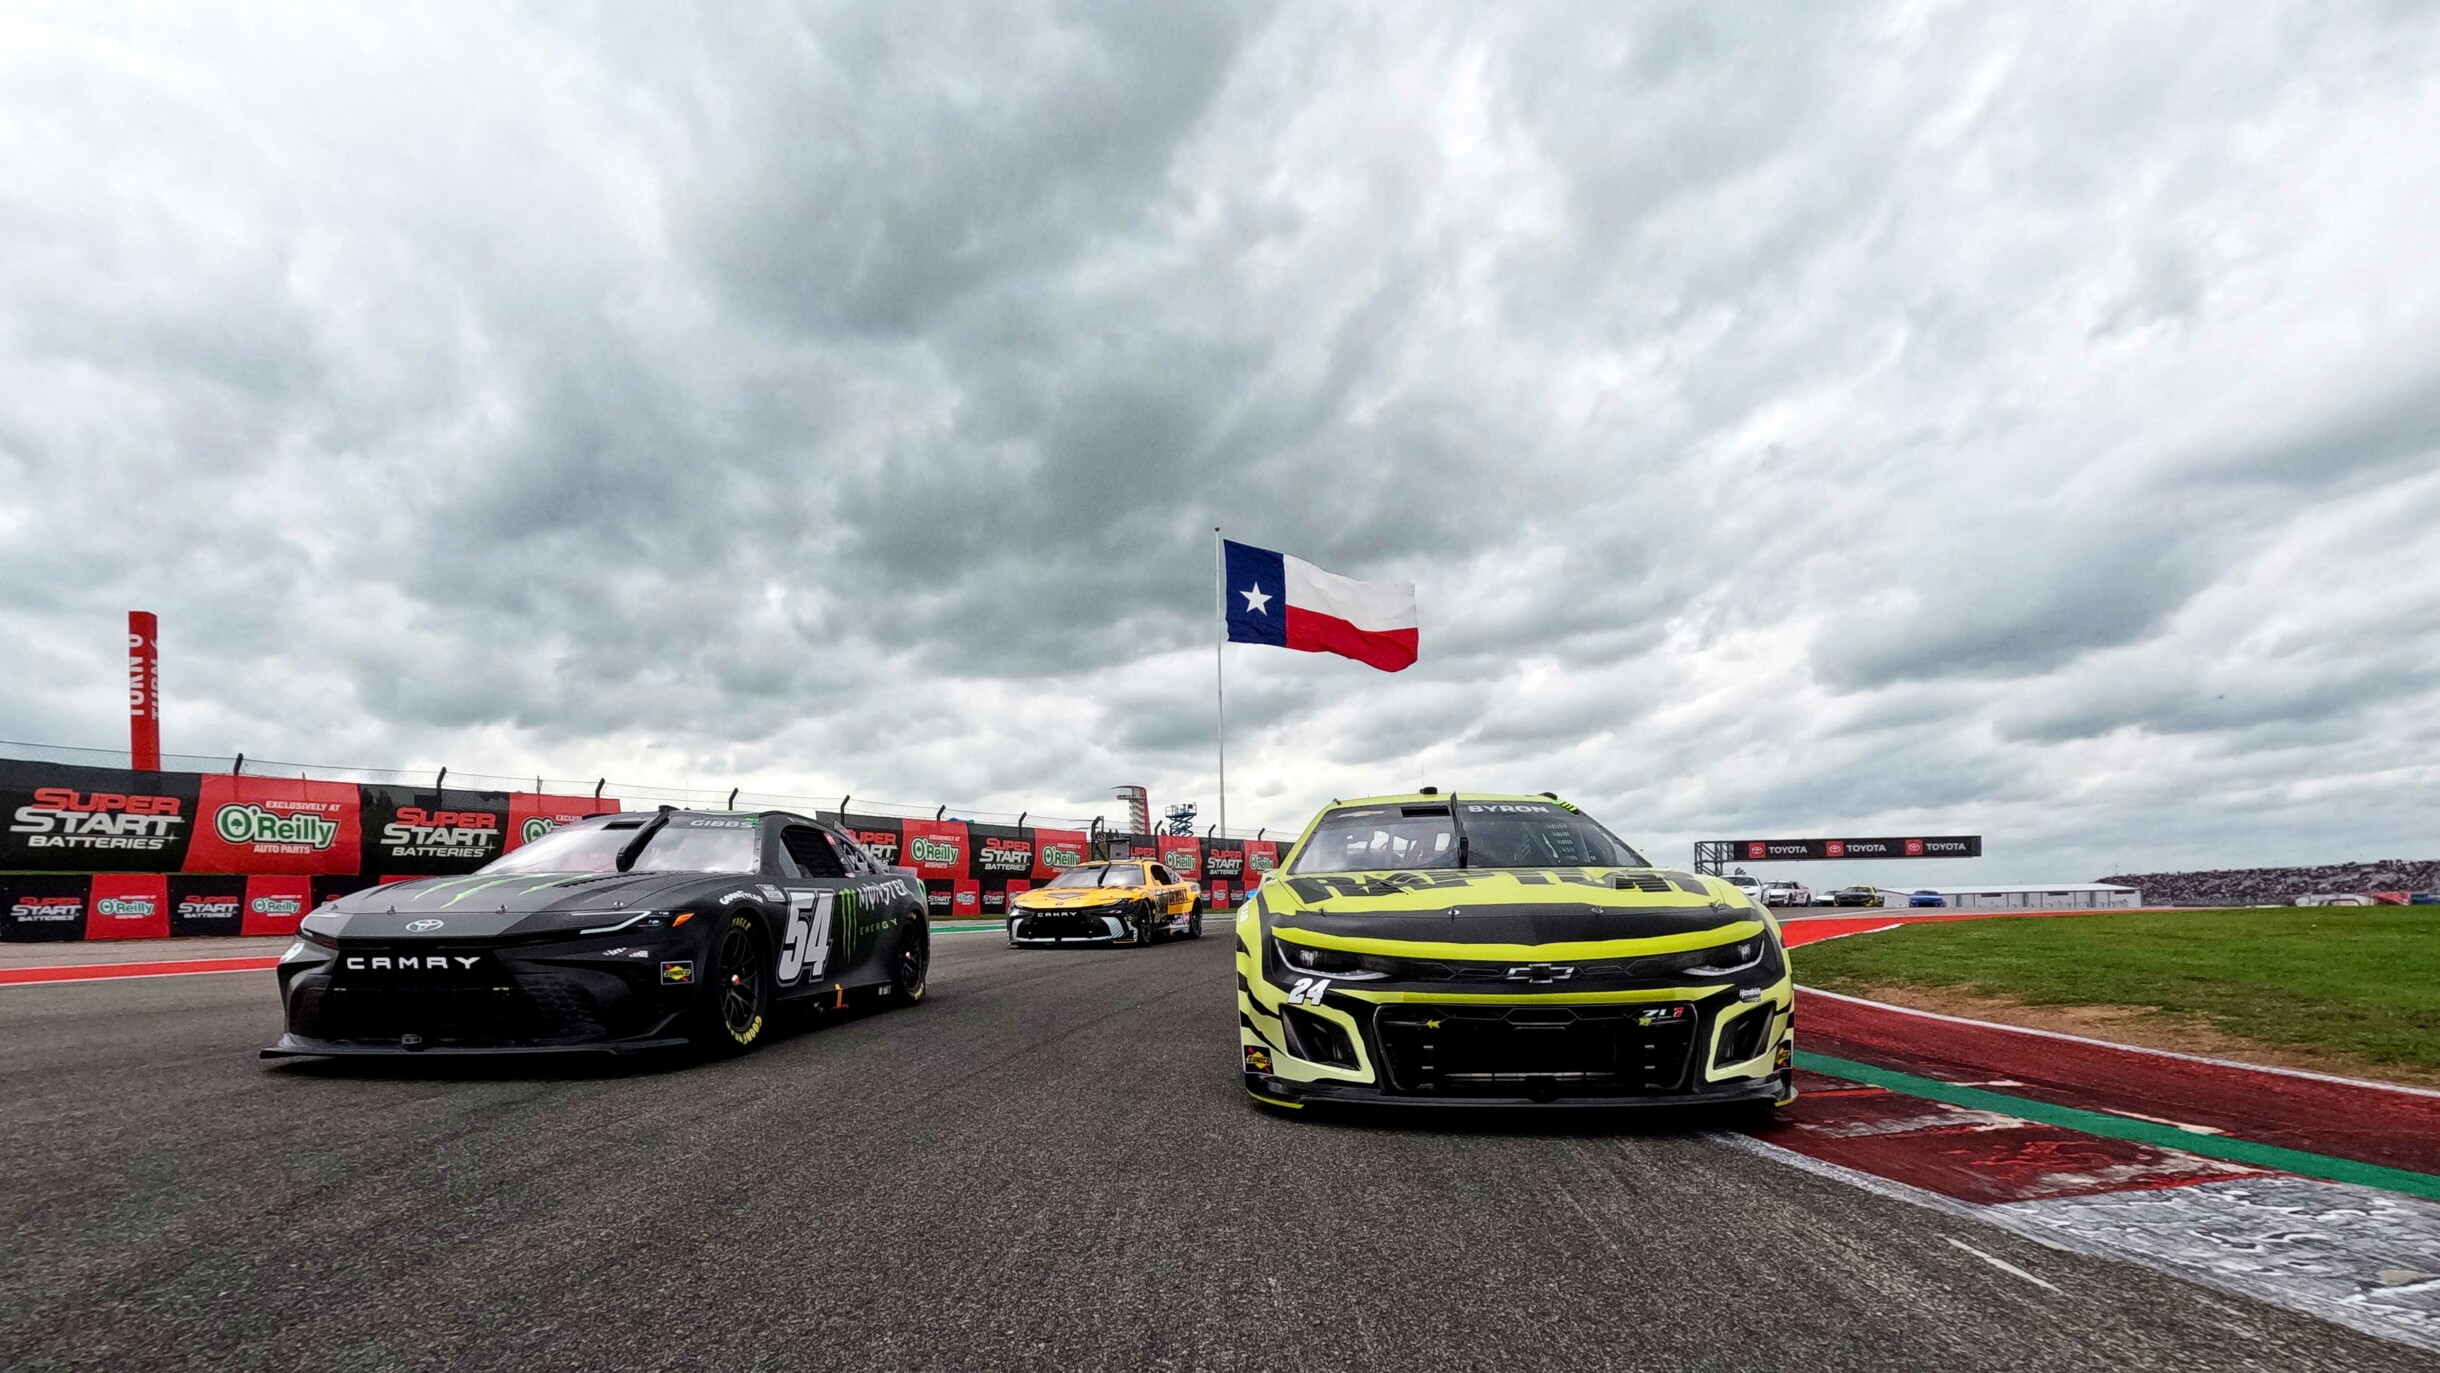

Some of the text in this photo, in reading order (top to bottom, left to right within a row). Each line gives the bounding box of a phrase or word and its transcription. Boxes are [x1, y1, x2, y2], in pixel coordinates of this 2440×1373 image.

[32, 787, 181, 815] SUPER
[265, 800, 341, 812] EXCLUSIVELY AT
[1468, 805, 1550, 813] BYRON
[10, 806, 183, 836] START
[395, 807, 497, 828] SUPER
[219, 806, 334, 847] O'Reilly
[690, 820, 754, 828] GIBBS
[380, 823, 499, 846] START
[28, 835, 165, 850] BATTERIES
[985, 838, 1031, 851] SUPER
[1846, 844, 1887, 852] TOYOTA
[1925, 843, 1967, 851] TOYOTA
[253, 844, 311, 854] AUTO PARTS
[392, 847, 486, 857] BATTERIES
[912, 839, 958, 864] O'Reilly
[1131, 847, 1156, 857] UPER
[1210, 849, 1242, 858] SUPER
[1768, 846, 1808, 854] TOYOTA
[979, 848, 1033, 863] START
[1166, 851, 1196, 870] O'Reilly
[984, 863, 1026, 871] BATTERIES
[1207, 857, 1243, 869] START
[857, 879, 914, 911] MONSTER
[10, 904, 83, 916] START
[99, 900, 154, 915] O'Reilly
[177, 903, 240, 913] START
[253, 898, 299, 913] O'Reilly
[860, 918, 898, 936] ENERGY
[778, 890, 833, 983] 54
[347, 956, 481, 969] CAMRY
[664, 969, 690, 977] SUNOCO
[1287, 978, 1332, 1006] 24
[1739, 987, 1762, 998] Hendrick
[1246, 1056, 1272, 1066] SUNOCO
